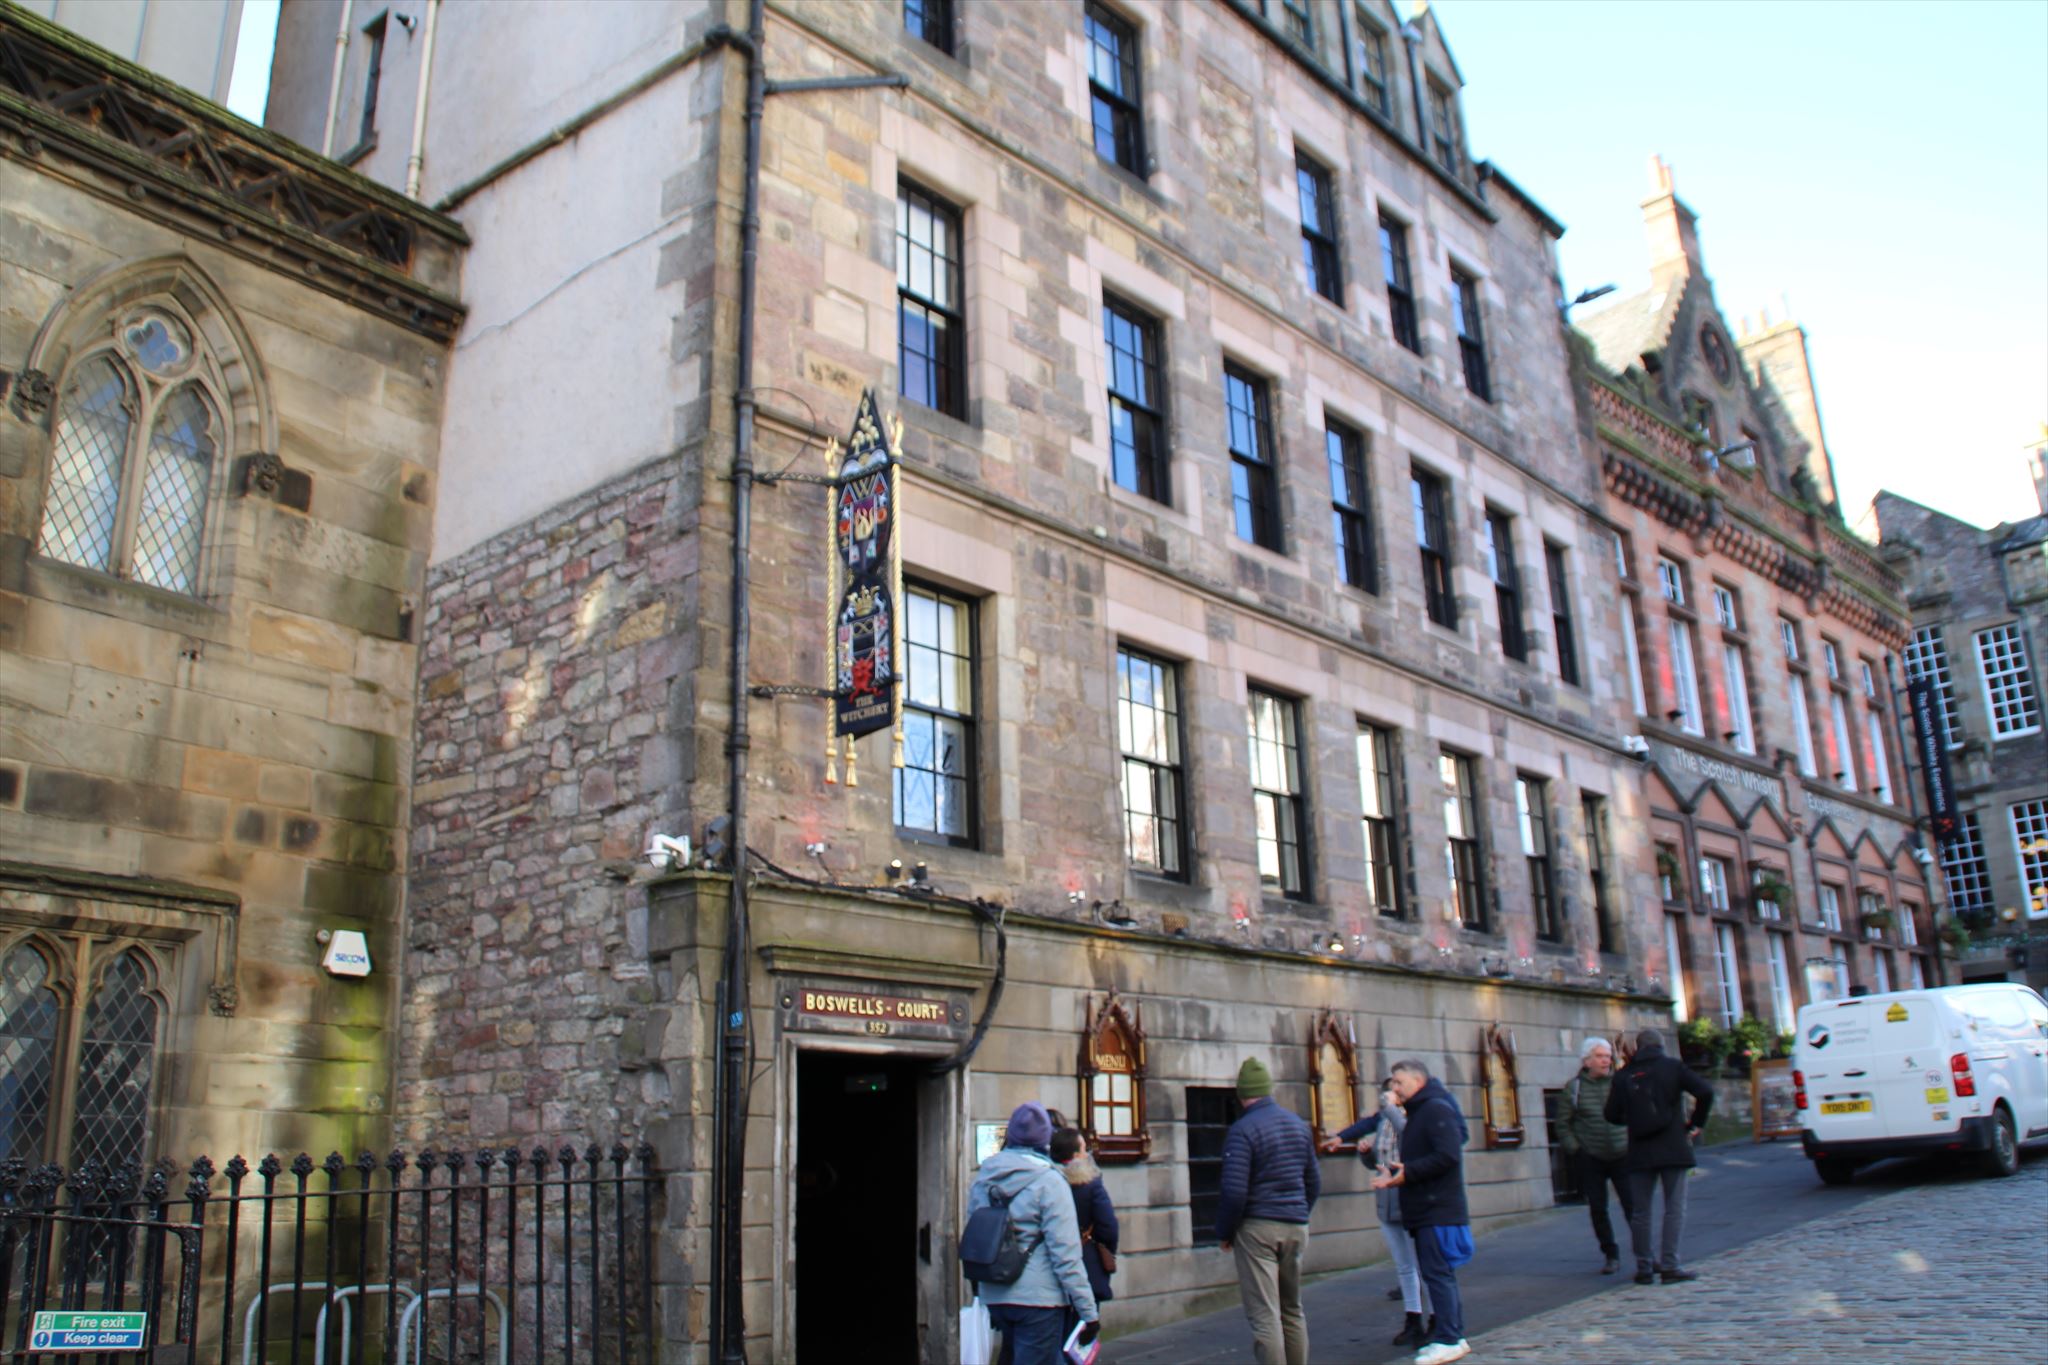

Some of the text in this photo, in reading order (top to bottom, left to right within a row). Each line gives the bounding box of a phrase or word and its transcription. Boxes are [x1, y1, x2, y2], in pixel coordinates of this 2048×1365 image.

[856, 694, 874, 707] THE
[840, 701, 889, 723] WITCHERY
[1918, 691, 1946, 812] The Scotch Whisky Experience
[1674, 747, 1698, 773] The
[1700, 757, 1739, 785] Scotch
[1741, 769, 1780, 803] Whisky
[868, 1022, 887, 1034] 352
[1095, 1054, 1126, 1068] MENU
[71, 1316, 126, 1328] Fire exit
[64, 1333, 129, 1345] Keep clear
